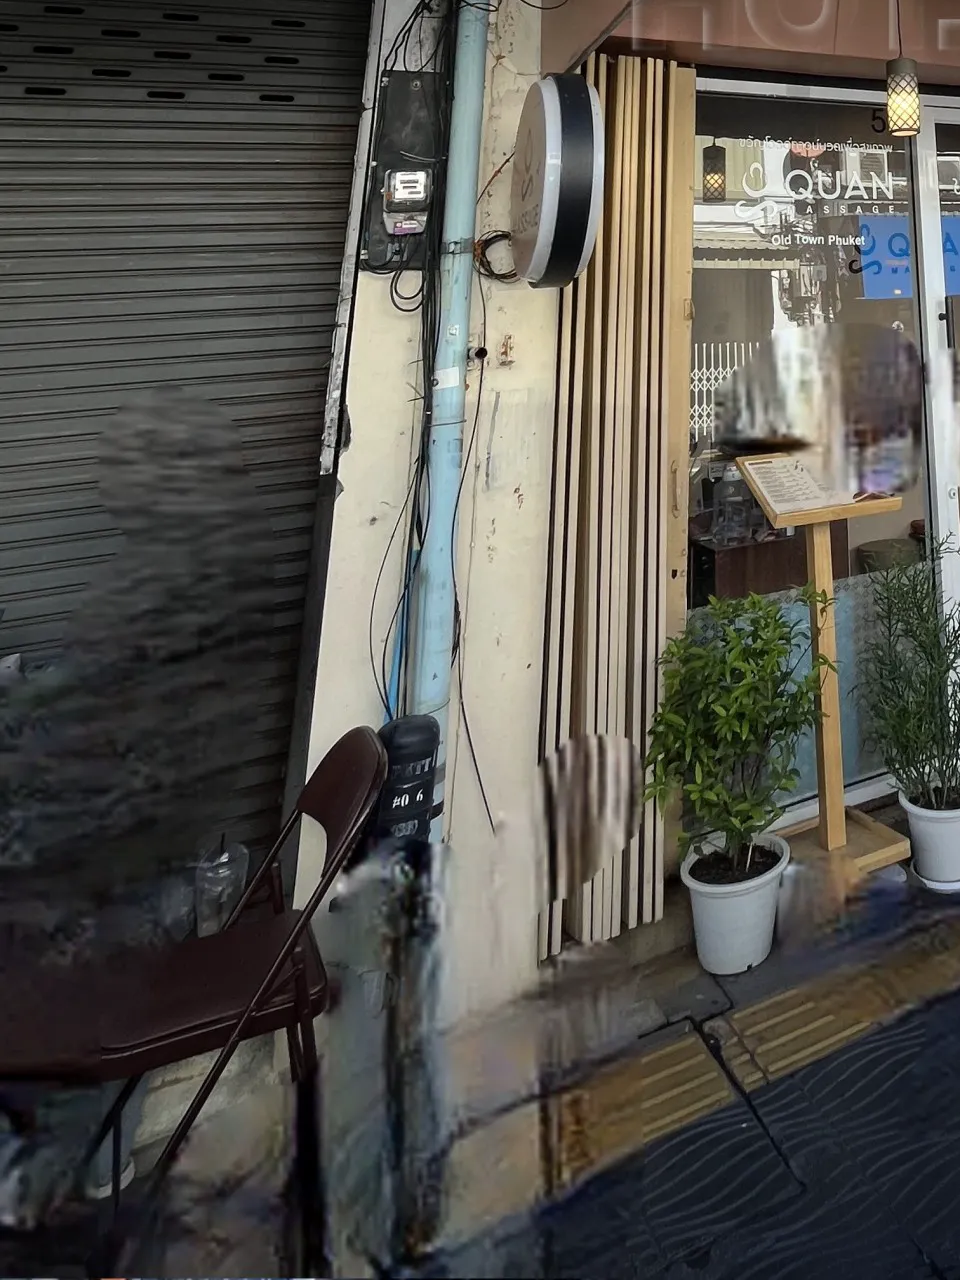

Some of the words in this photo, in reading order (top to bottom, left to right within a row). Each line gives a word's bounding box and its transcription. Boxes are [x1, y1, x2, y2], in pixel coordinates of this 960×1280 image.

[785, 169, 894, 203] QUAN
[788, 205, 895, 214] ASSAGE
[771, 234, 792, 246] Old
[796, 234, 825, 245] Town
[828, 234, 866, 246] Phuket
